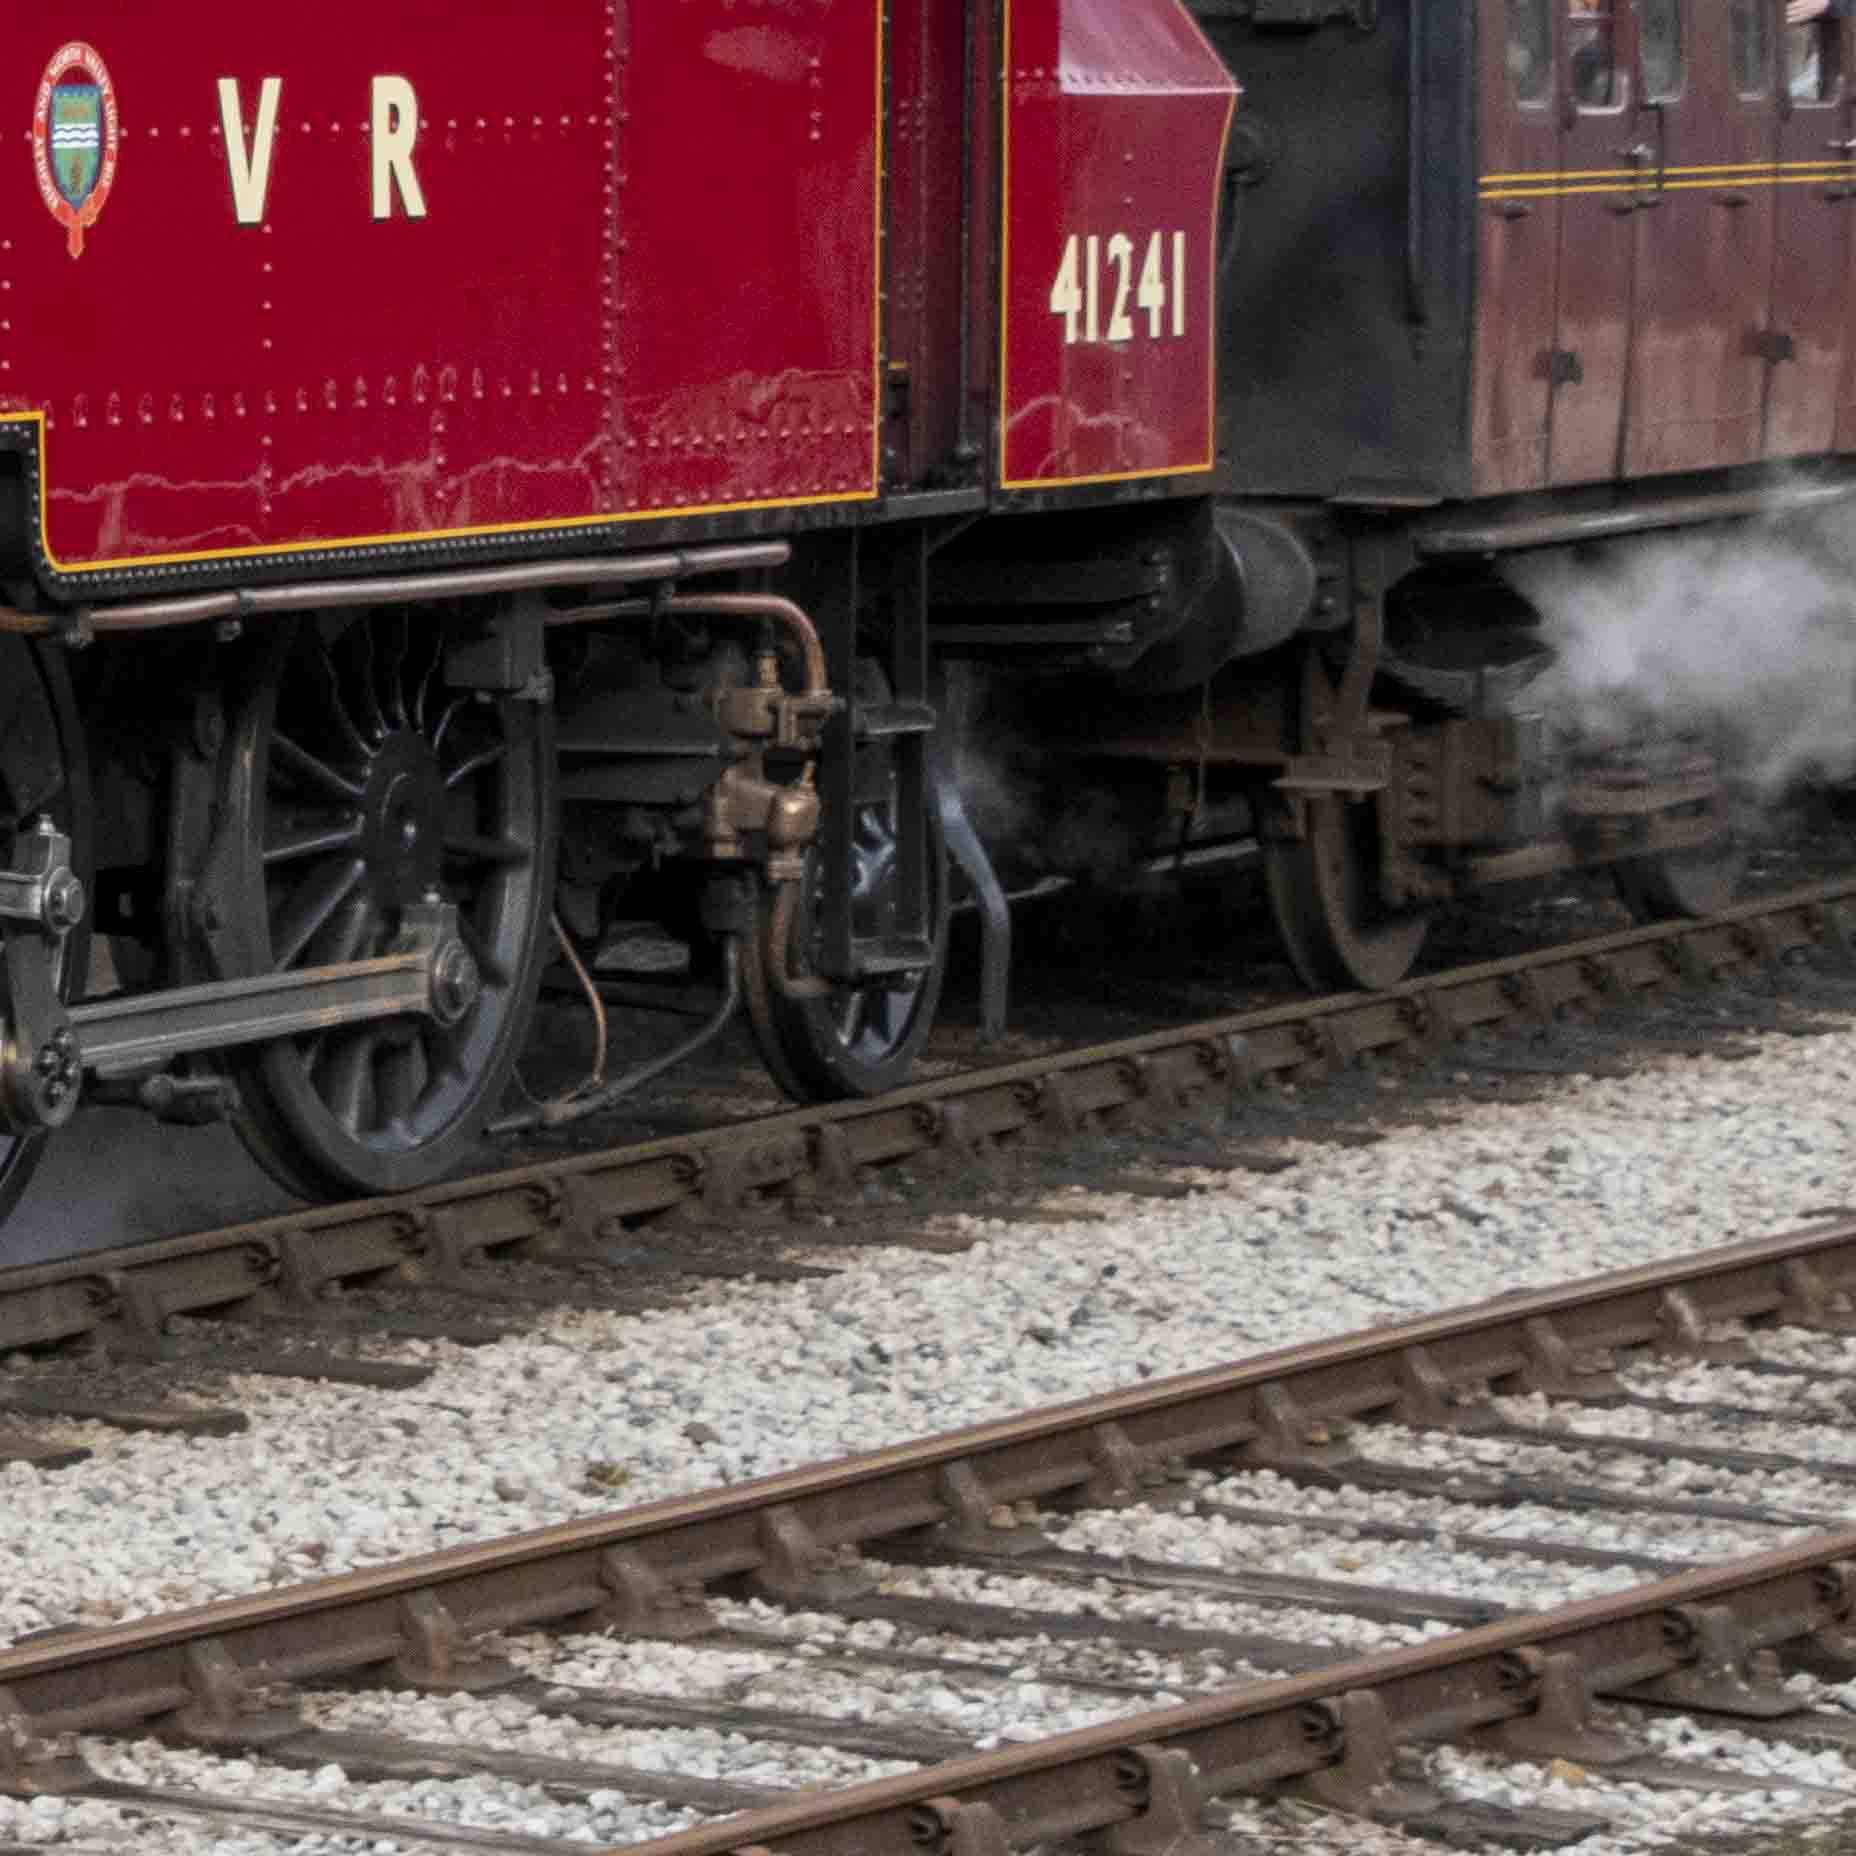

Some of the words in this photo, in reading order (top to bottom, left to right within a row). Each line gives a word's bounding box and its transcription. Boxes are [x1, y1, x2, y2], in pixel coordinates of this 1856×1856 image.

[217, 77, 282, 225] V
[371, 75, 427, 223] R
[1049, 229, 1187, 347] 41241
